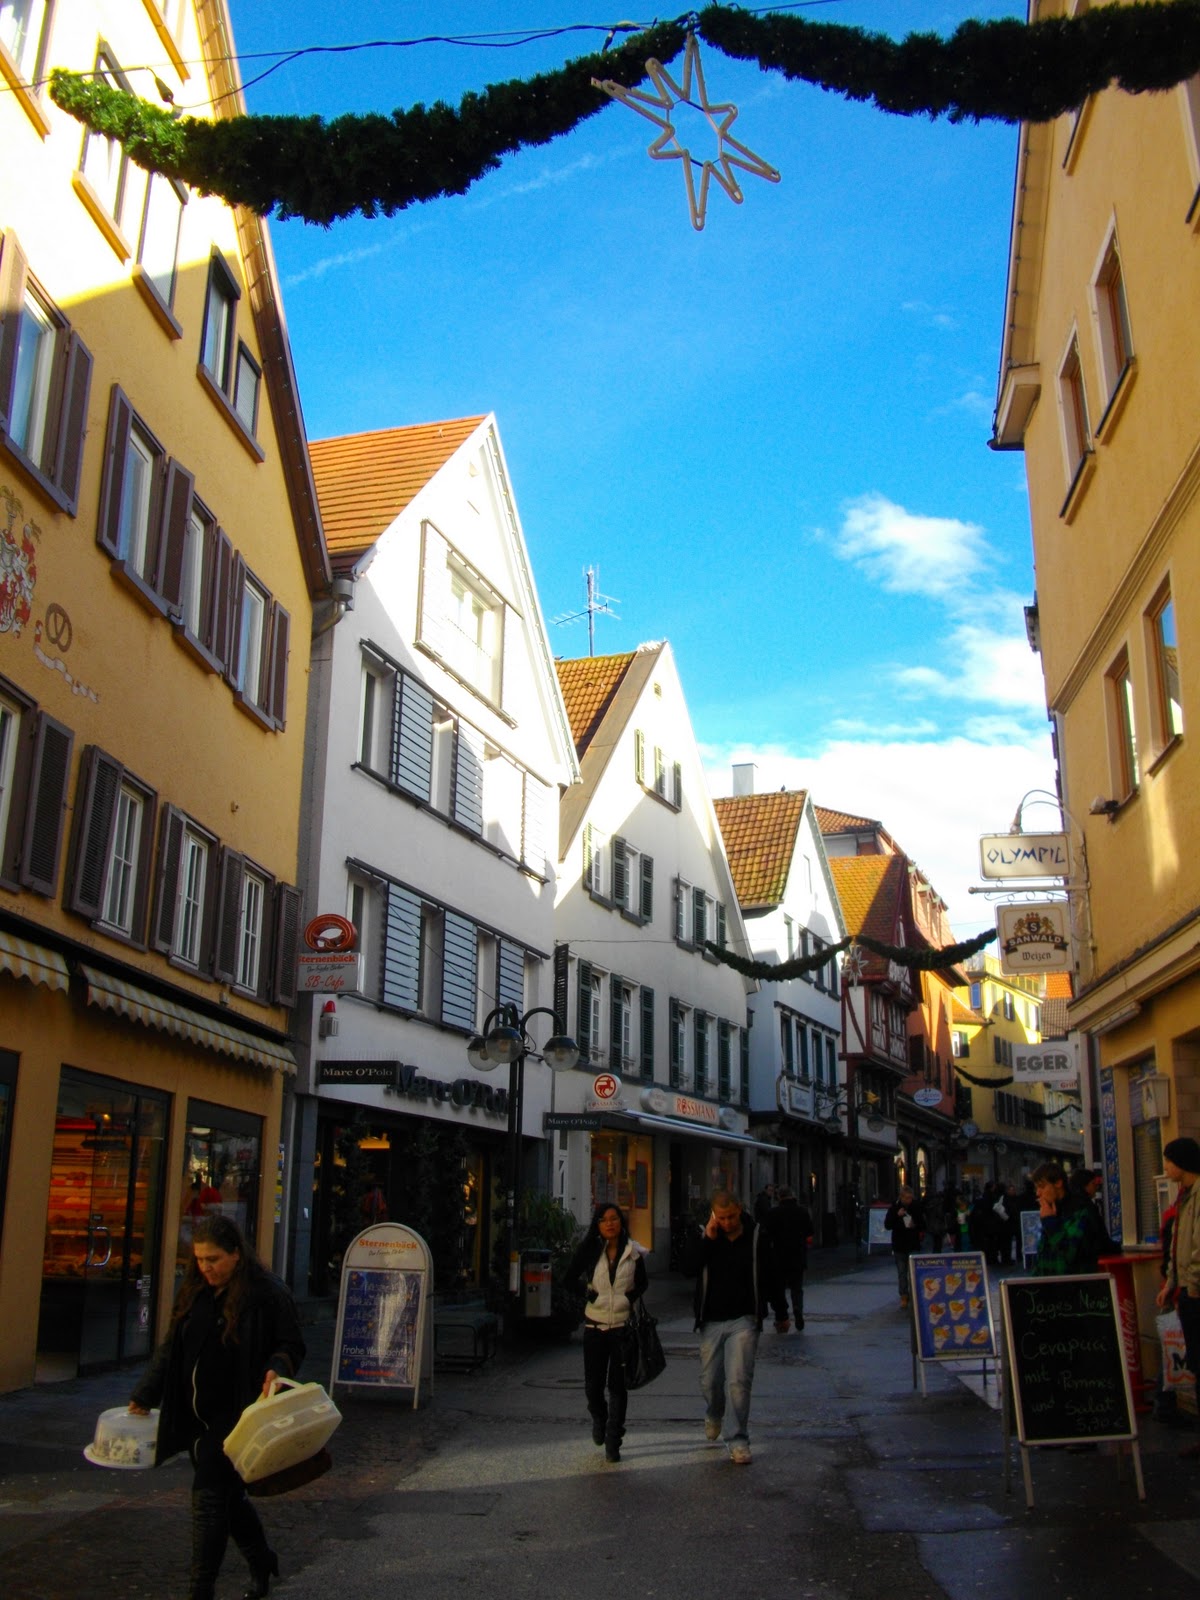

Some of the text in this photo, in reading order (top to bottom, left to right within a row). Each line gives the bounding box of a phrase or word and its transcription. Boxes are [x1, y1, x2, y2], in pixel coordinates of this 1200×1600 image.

[1008, 934, 1062, 947] SANWALD
[1022, 951, 1052, 961] Weizen
[1016, 1055, 1068, 1072] EGER
[322, 1068, 393, 1077] Marc O'Polo
[676, 1097, 716, 1120] ROSSMANN
[359, 1238, 417, 1249] Sternenbäck
[342, 1344, 364, 1355] Frohe
[1024, 1365, 1050, 1385] mit
